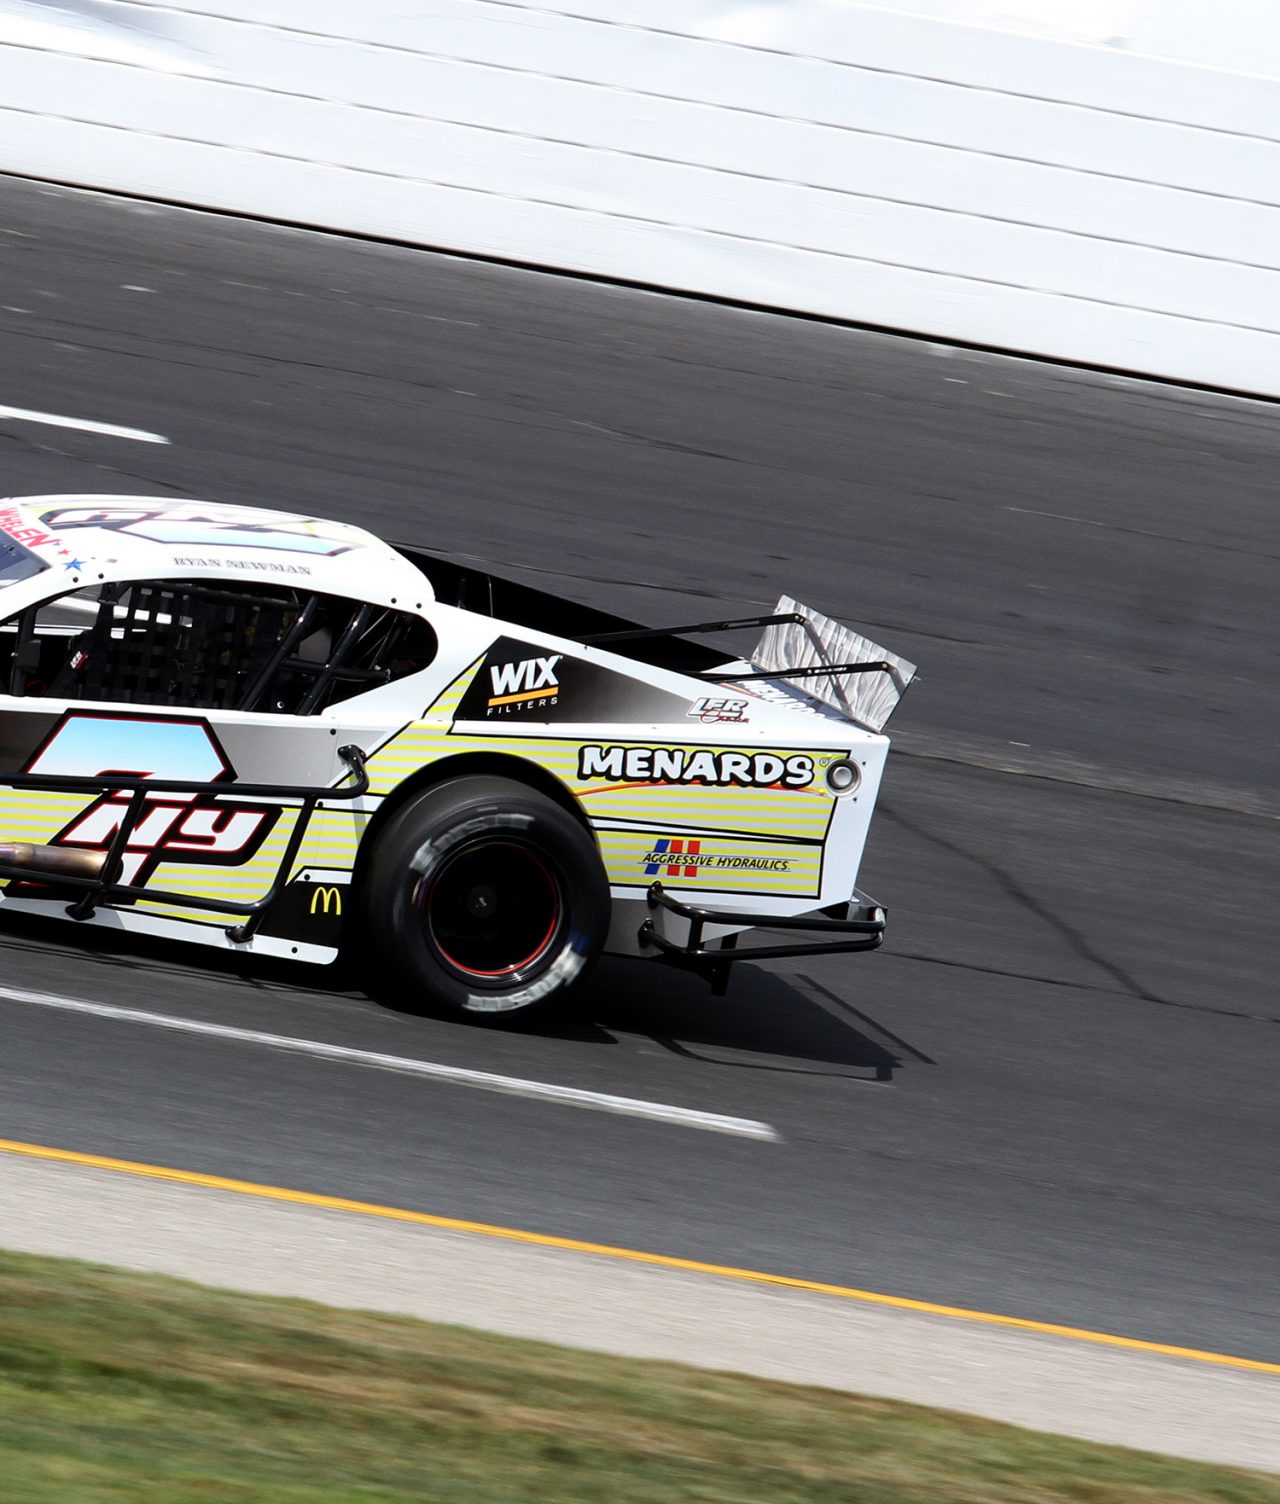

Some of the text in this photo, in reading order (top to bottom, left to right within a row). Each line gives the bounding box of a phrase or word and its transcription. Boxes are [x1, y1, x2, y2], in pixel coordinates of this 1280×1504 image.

[172, 557, 313, 575] RYAN NEWMAN
[490, 655, 561, 696] WIX
[486, 696, 558, 716] FILTERS
[577, 744, 816, 789] MENARDS
[642, 853, 790, 871] AGGRESSIVE HYDRAULICS
